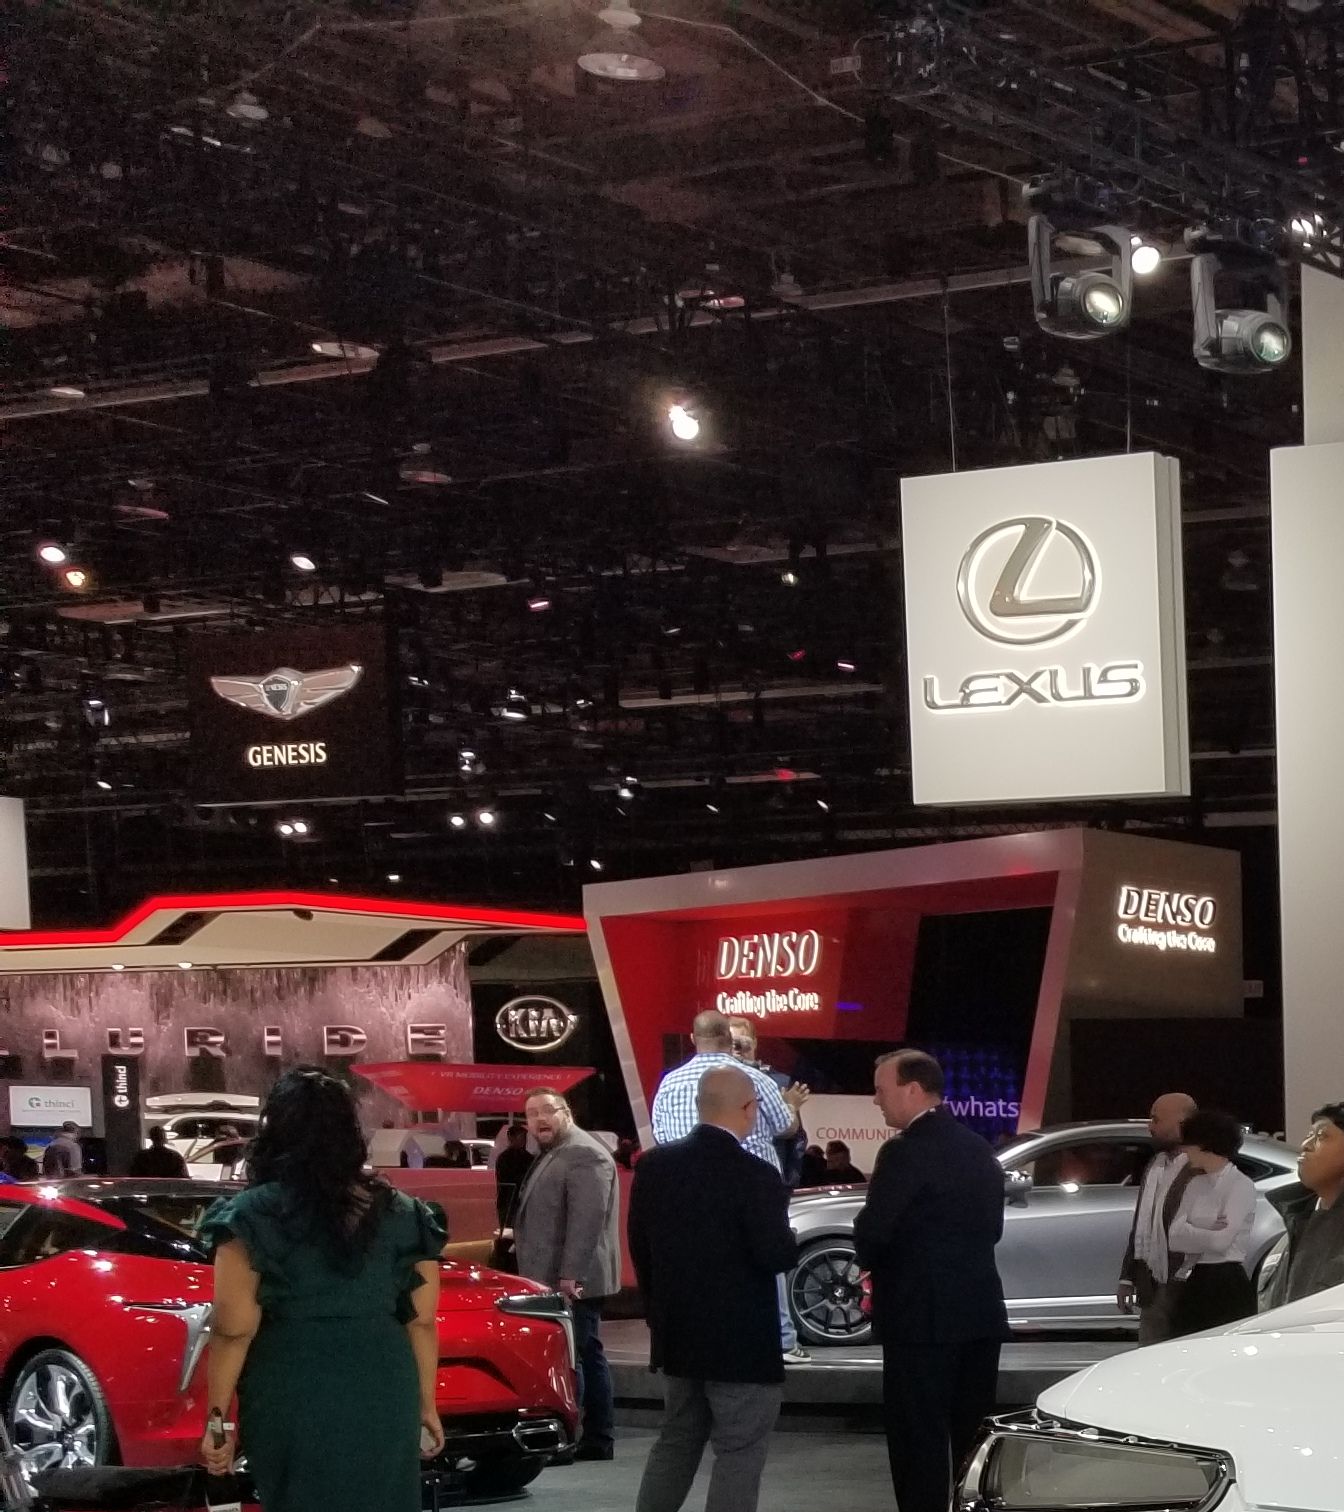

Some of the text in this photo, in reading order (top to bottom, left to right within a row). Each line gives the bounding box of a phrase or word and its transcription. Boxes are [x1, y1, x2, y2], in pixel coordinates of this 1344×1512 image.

[922, 662, 1142, 711] LEXUS
[247, 742, 327, 767] GENESIS
[1118, 885, 1217, 929] DENSO
[1118, 923, 1217, 953] Crafting the Core
[717, 929, 820, 980] DENSO
[717, 987, 820, 1018] Crafting the Core
[508, 1008, 561, 1038] KIA
[0, 1023, 447, 1059] LURIDE
[472, 1086, 524, 1096] DENSO
